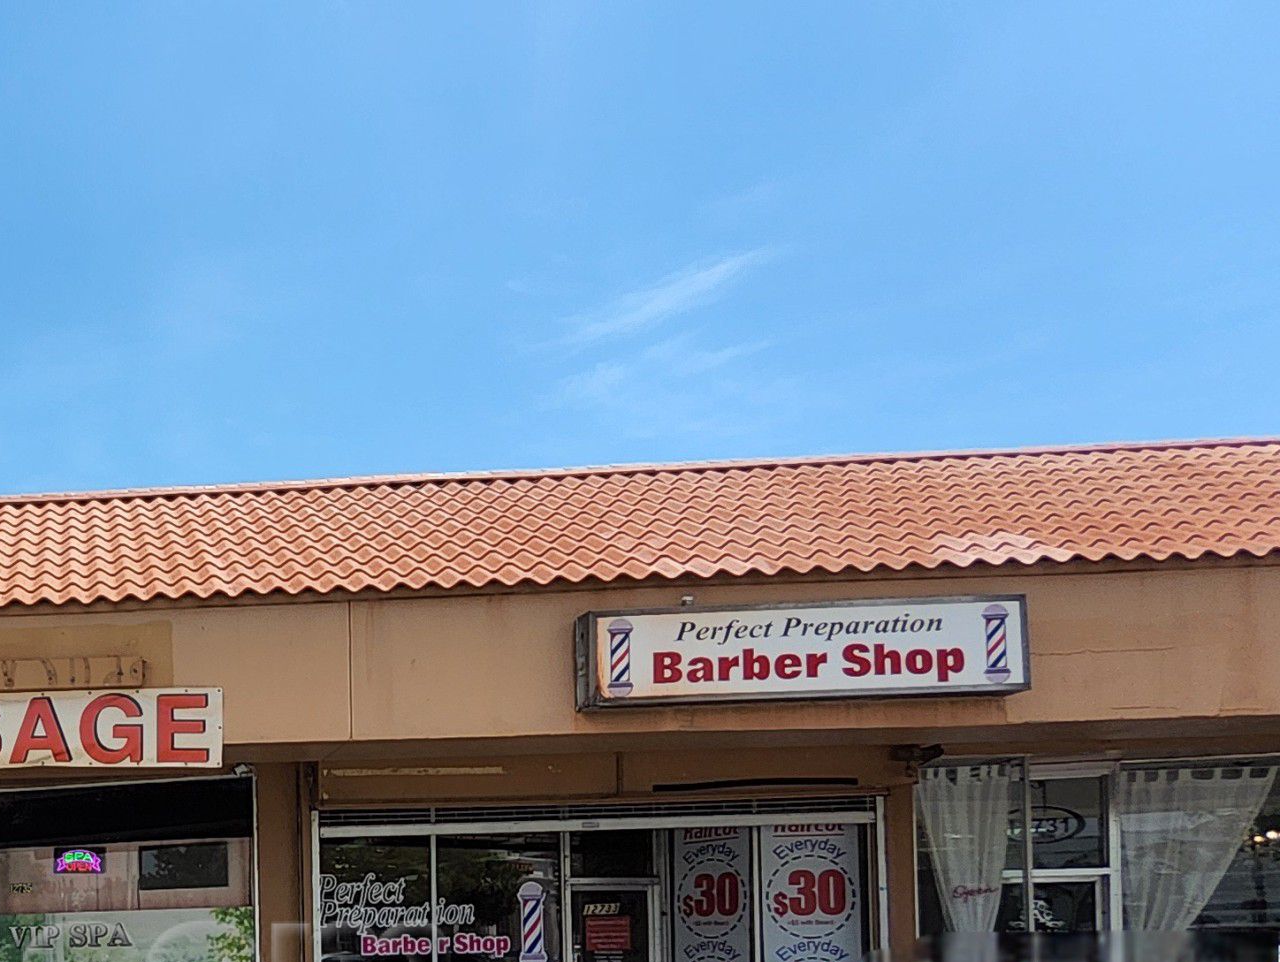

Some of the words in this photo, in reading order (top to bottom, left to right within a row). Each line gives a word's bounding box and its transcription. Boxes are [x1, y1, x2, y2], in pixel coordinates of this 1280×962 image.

[674, 617, 773, 645] Perfect
[780, 614, 943, 641] Preparation
[652, 648, 828, 684] Barber
[842, 642, 965, 682] Shop
[64, 852, 93, 863] SPA
[683, 842, 739, 864] Everyday
[772, 838, 847, 860] Everyday
[66, 863, 92, 872] OPEN
[320, 873, 406, 908] Perfect
[683, 872, 739, 918] $30
[773, 869, 846, 918] $30
[9, 926, 60, 949] VIP
[69, 922, 133, 948] SPA
[361, 934, 451, 956] Barber
[453, 933, 511, 957] Shop
[684, 940, 741, 960] Everyday
[775, 939, 849, 961] Everyday
